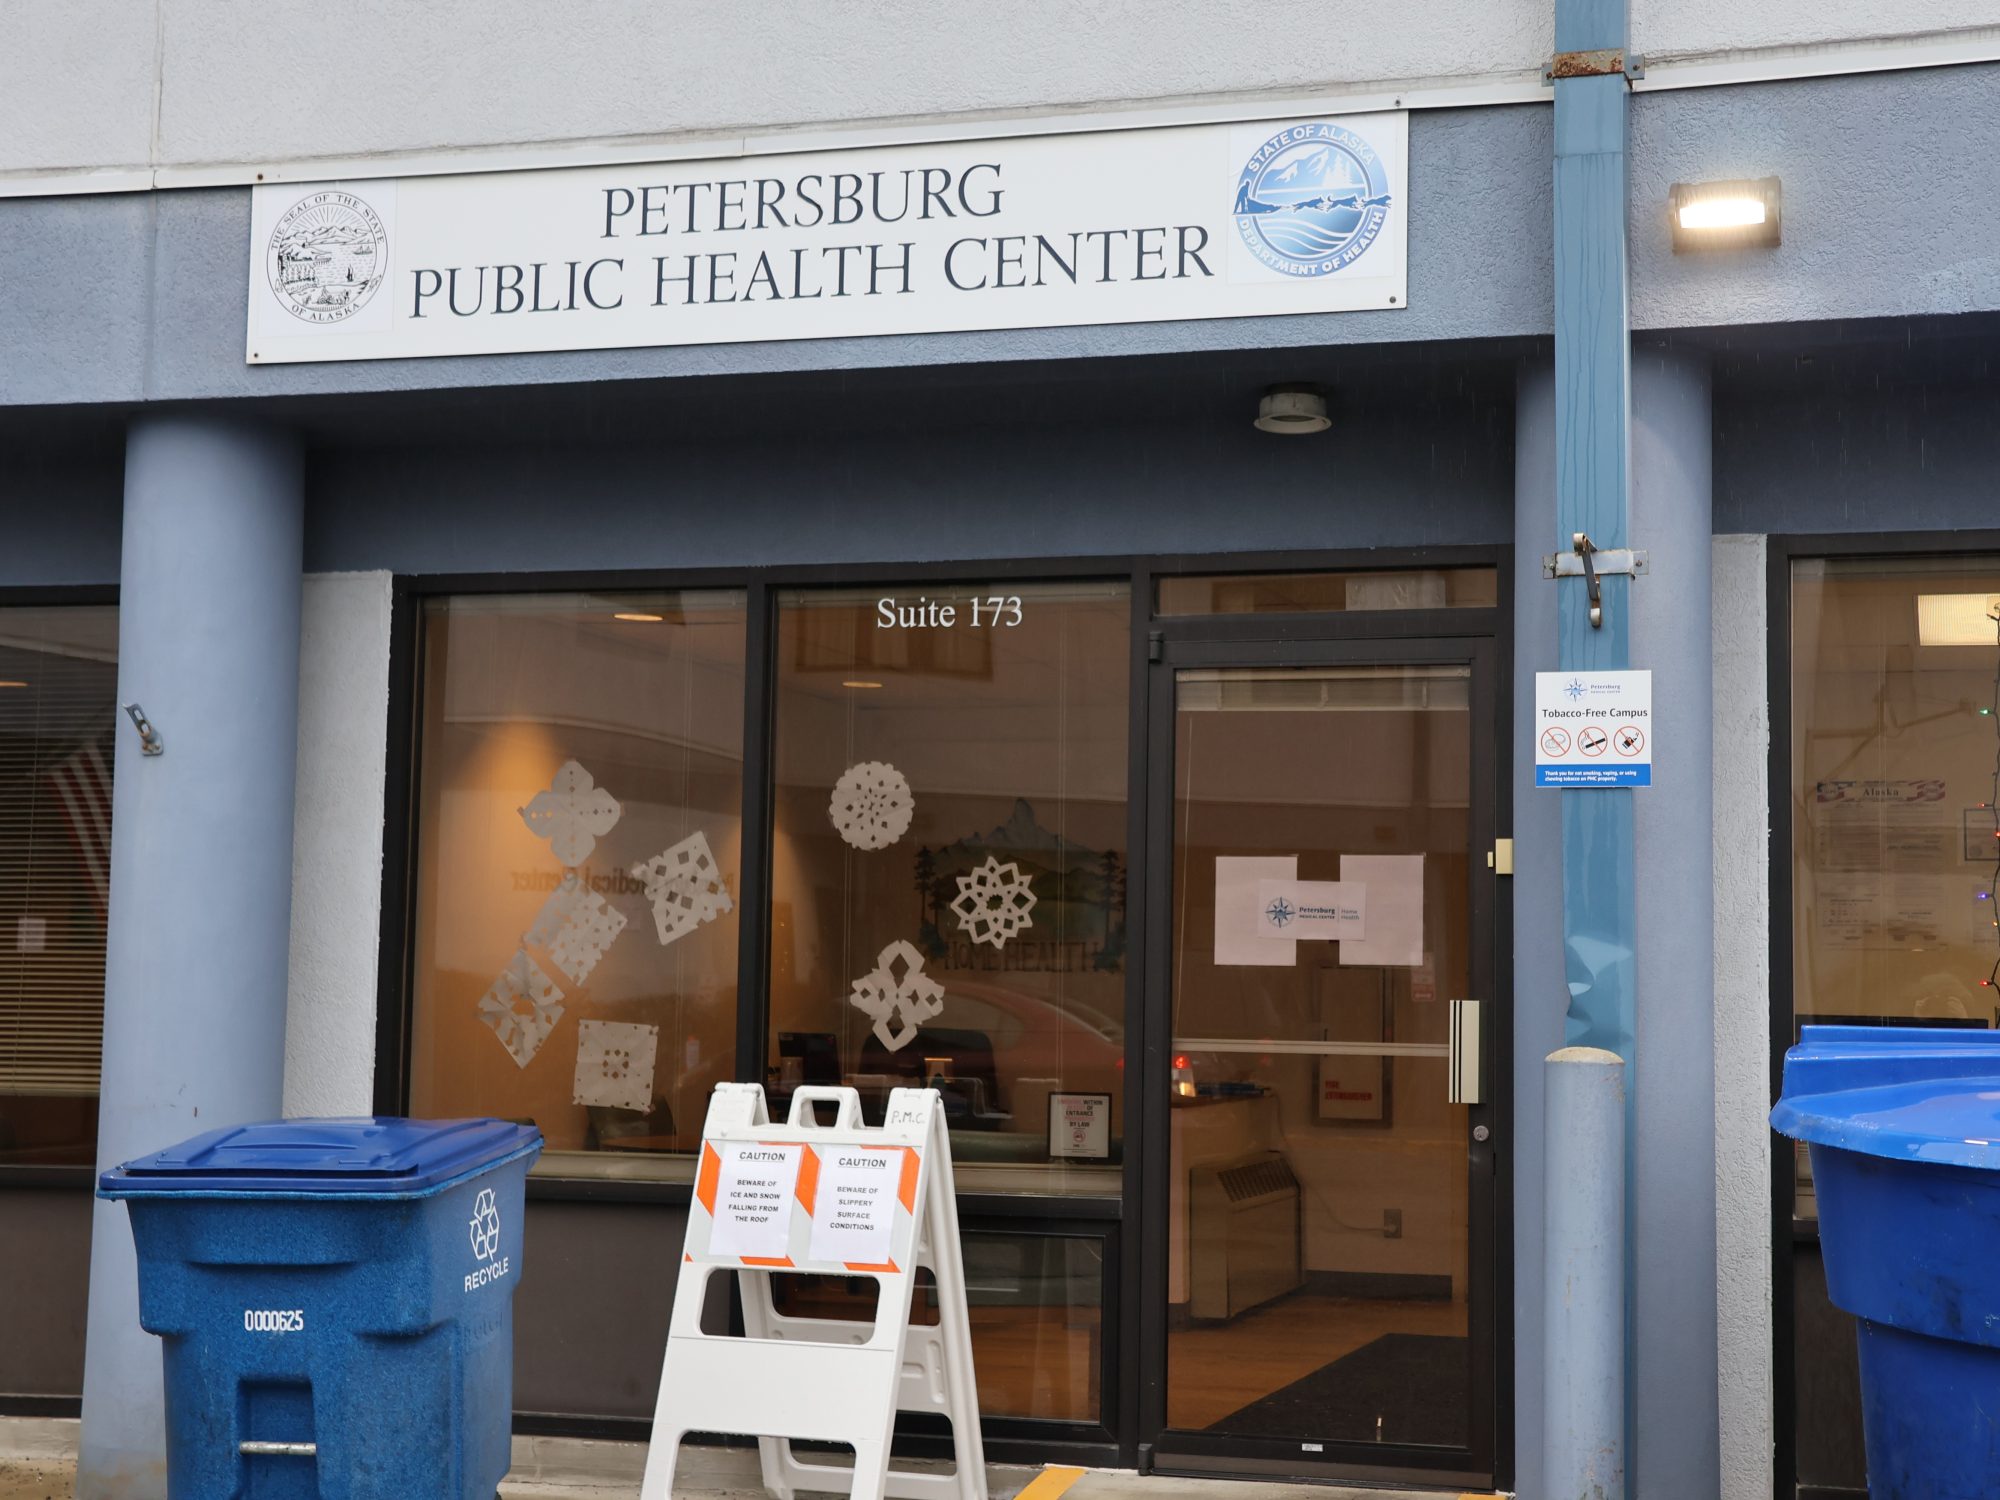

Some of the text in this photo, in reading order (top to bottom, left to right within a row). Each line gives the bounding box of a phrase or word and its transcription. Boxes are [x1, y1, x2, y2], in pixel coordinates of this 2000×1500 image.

[1248, 125, 1377, 173] STATE OF ALASKA
[600, 163, 1005, 239] PETERSBURG
[271, 194, 386, 251] THE SEAL OF THE STATE
[1239, 211, 1384, 275] DEPARTMENT OF HEALTH
[409, 225, 1215, 319] PUBLIC HEALTH CENTER
[291, 302, 360, 322] OF ALASKA
[877, 596, 1023, 628] Suite 173
[1542, 708, 1648, 719] Tobacco-Free Campus
[1863, 788, 1899, 797] Alaska
[1299, 906, 1335, 915] Petersburg
[739, 1151, 786, 1162] CAUTION
[838, 1157, 887, 1168] CAUTION
[737, 1179, 766, 1187] BEWARE
[730, 1191, 742, 1199] ICE
[759, 1192, 781, 1200] SNOW
[837, 1186, 878, 1195] BEWARE OF
[728, 1204, 757, 1212] FALLING
[838, 1198, 873, 1207] SLIPPERY
[735, 1215, 749, 1223] THE
[837, 1211, 870, 1219] SURFACE
[830, 1222, 874, 1231] CONDITIONS
[464, 1257, 509, 1293] RECYCLE
[244, 1309, 304, 1331] 0000625
